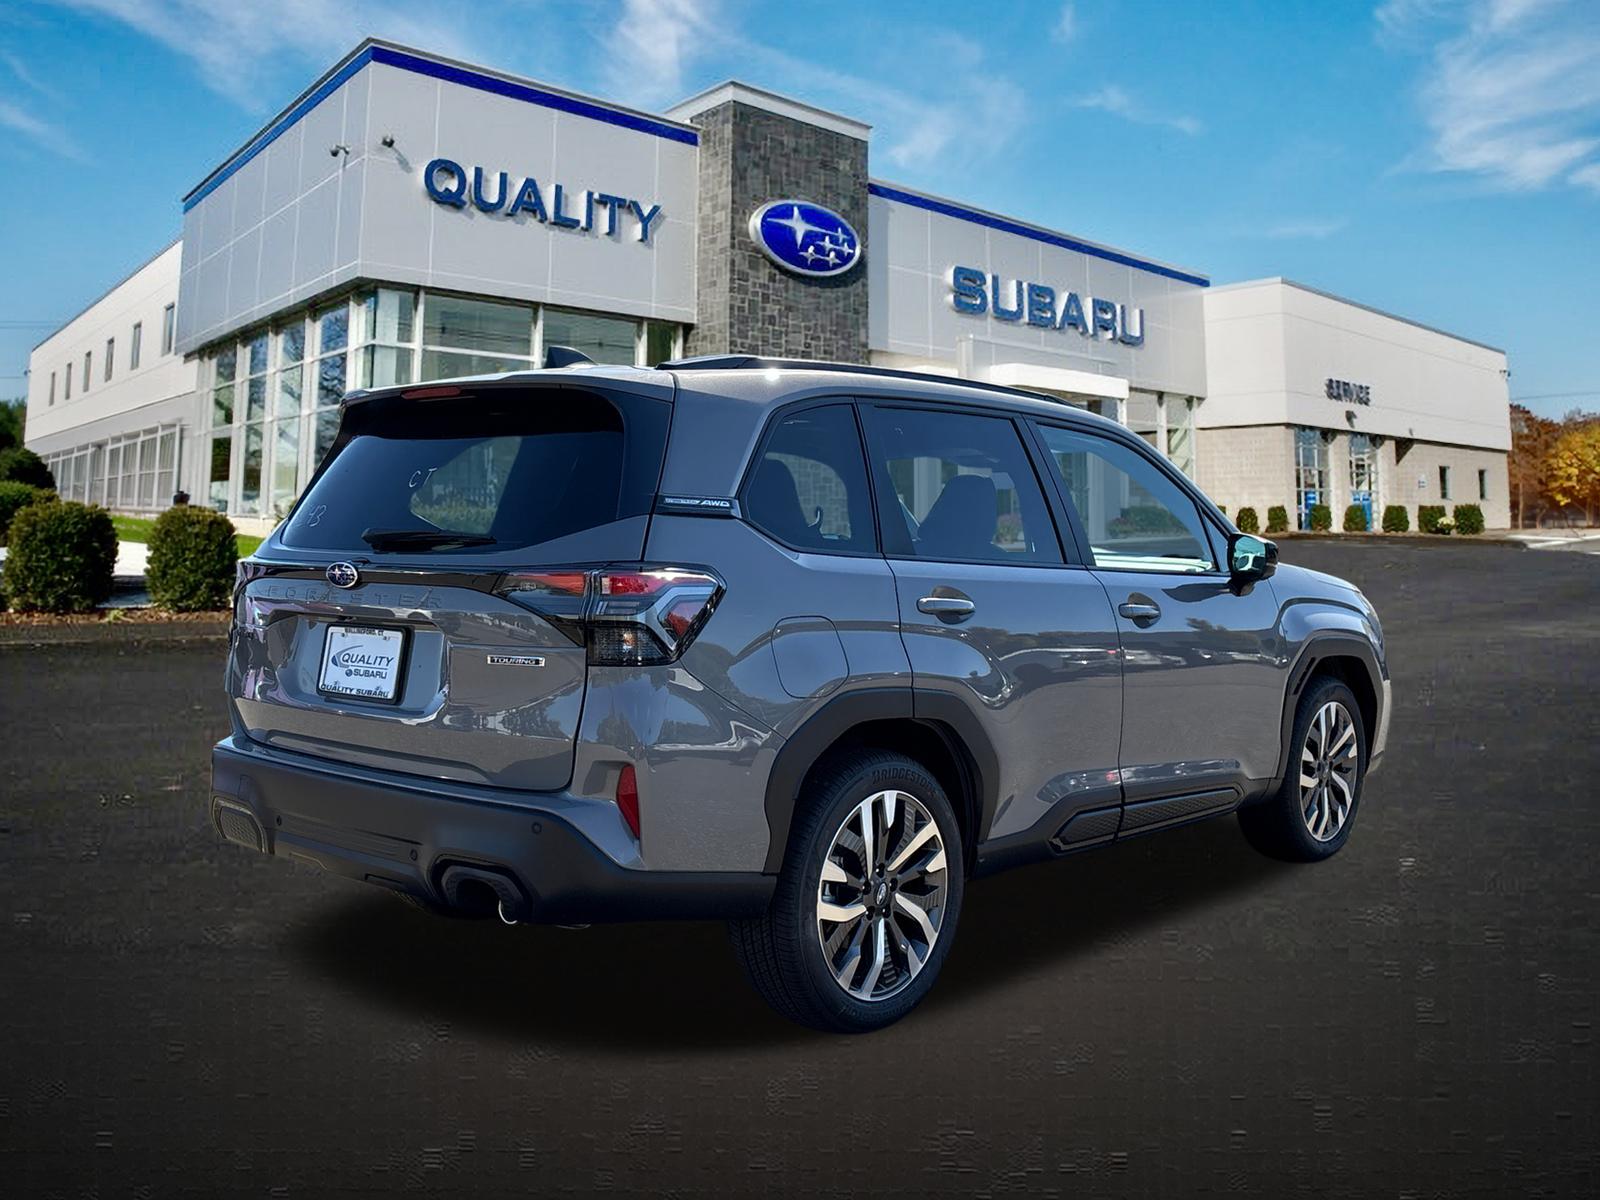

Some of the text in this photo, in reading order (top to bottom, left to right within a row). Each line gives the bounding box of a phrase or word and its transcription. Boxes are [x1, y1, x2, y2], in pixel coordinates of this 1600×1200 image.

[423, 157, 662, 243] QUALITY
[949, 264, 1145, 347] SUBARU
[700, 499, 730, 507] AWD
[267, 584, 443, 609] FORESTER
[342, 653, 394, 666] QUALITY
[492, 656, 536, 665] TOURING
[354, 669, 387, 679] SUBARU
[321, 684, 389, 697] QUALITY SUBARU
